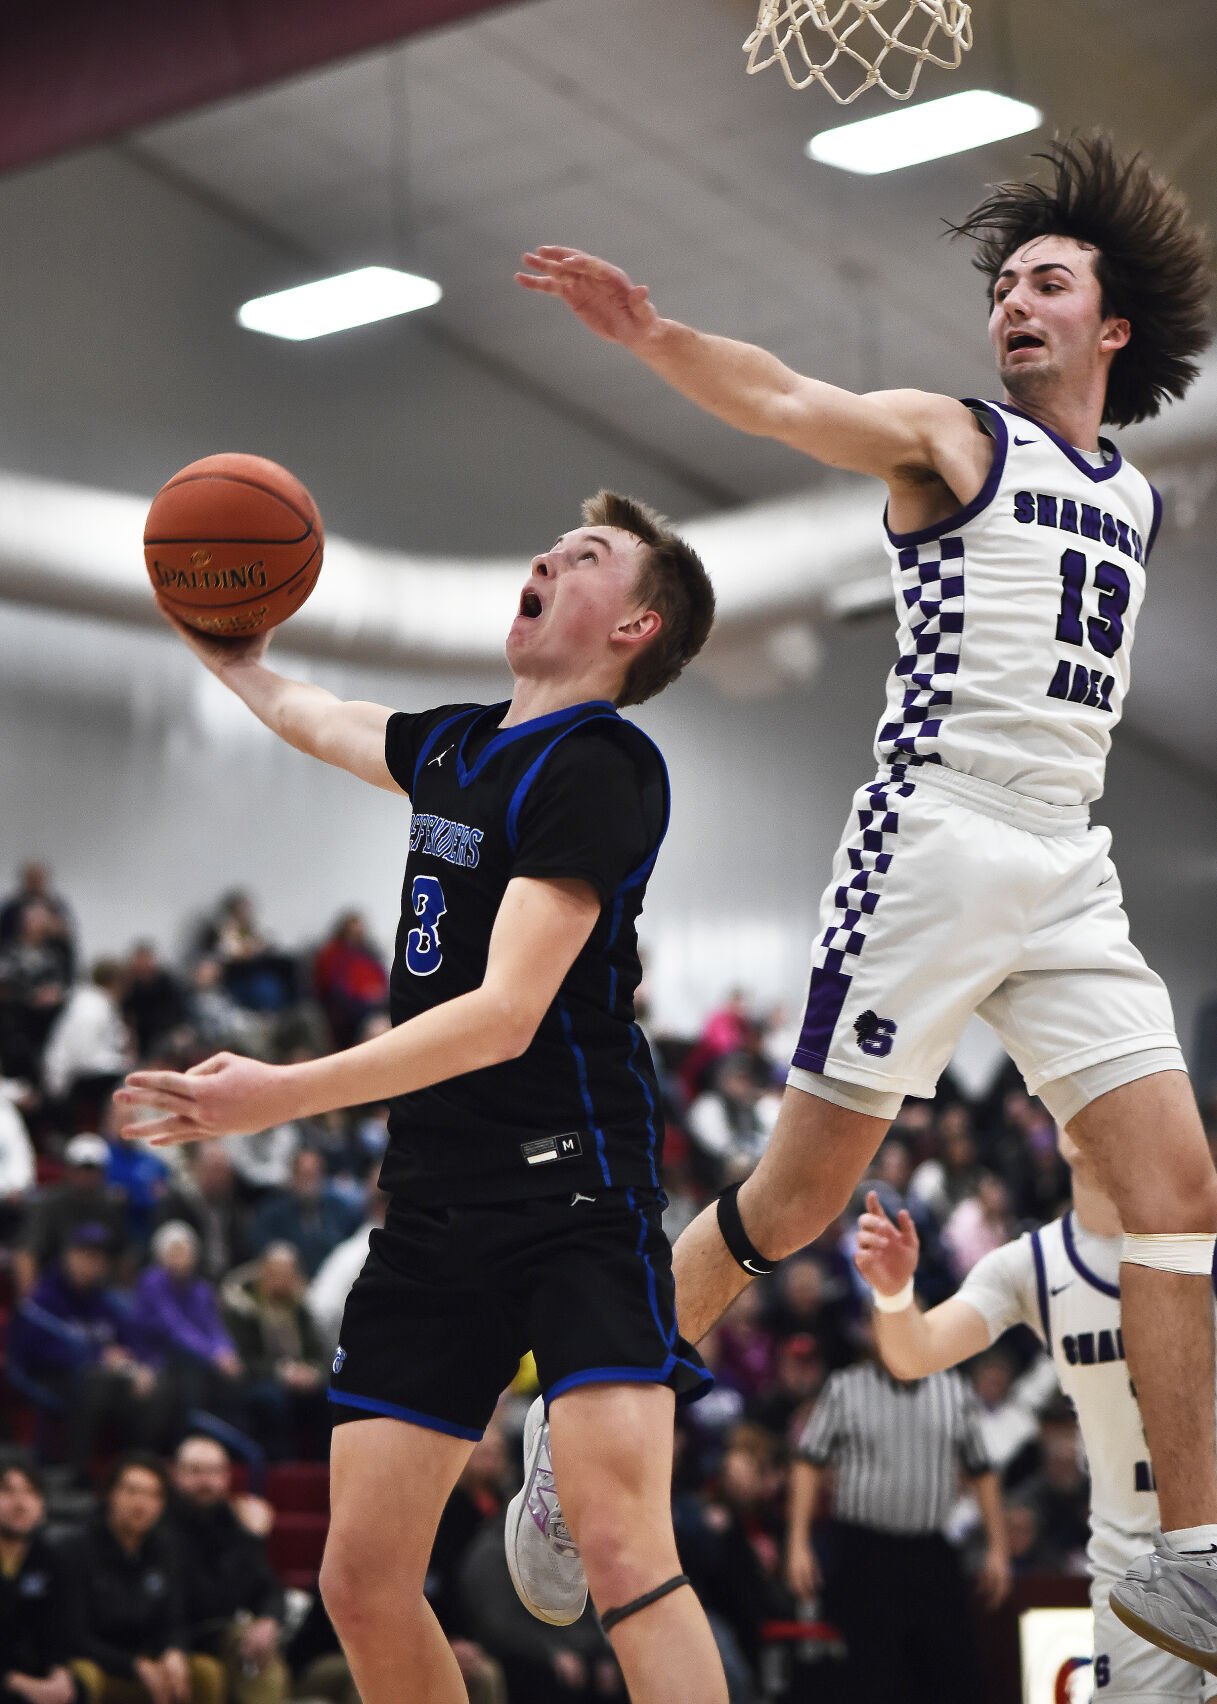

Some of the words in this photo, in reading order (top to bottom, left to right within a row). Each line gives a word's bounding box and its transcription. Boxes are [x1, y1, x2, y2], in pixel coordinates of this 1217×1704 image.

[153, 560, 267, 590] SPALDING
[1055, 548, 1130, 659] 13
[405, 875, 448, 977] 3
[562, 1139, 574, 1151] M
